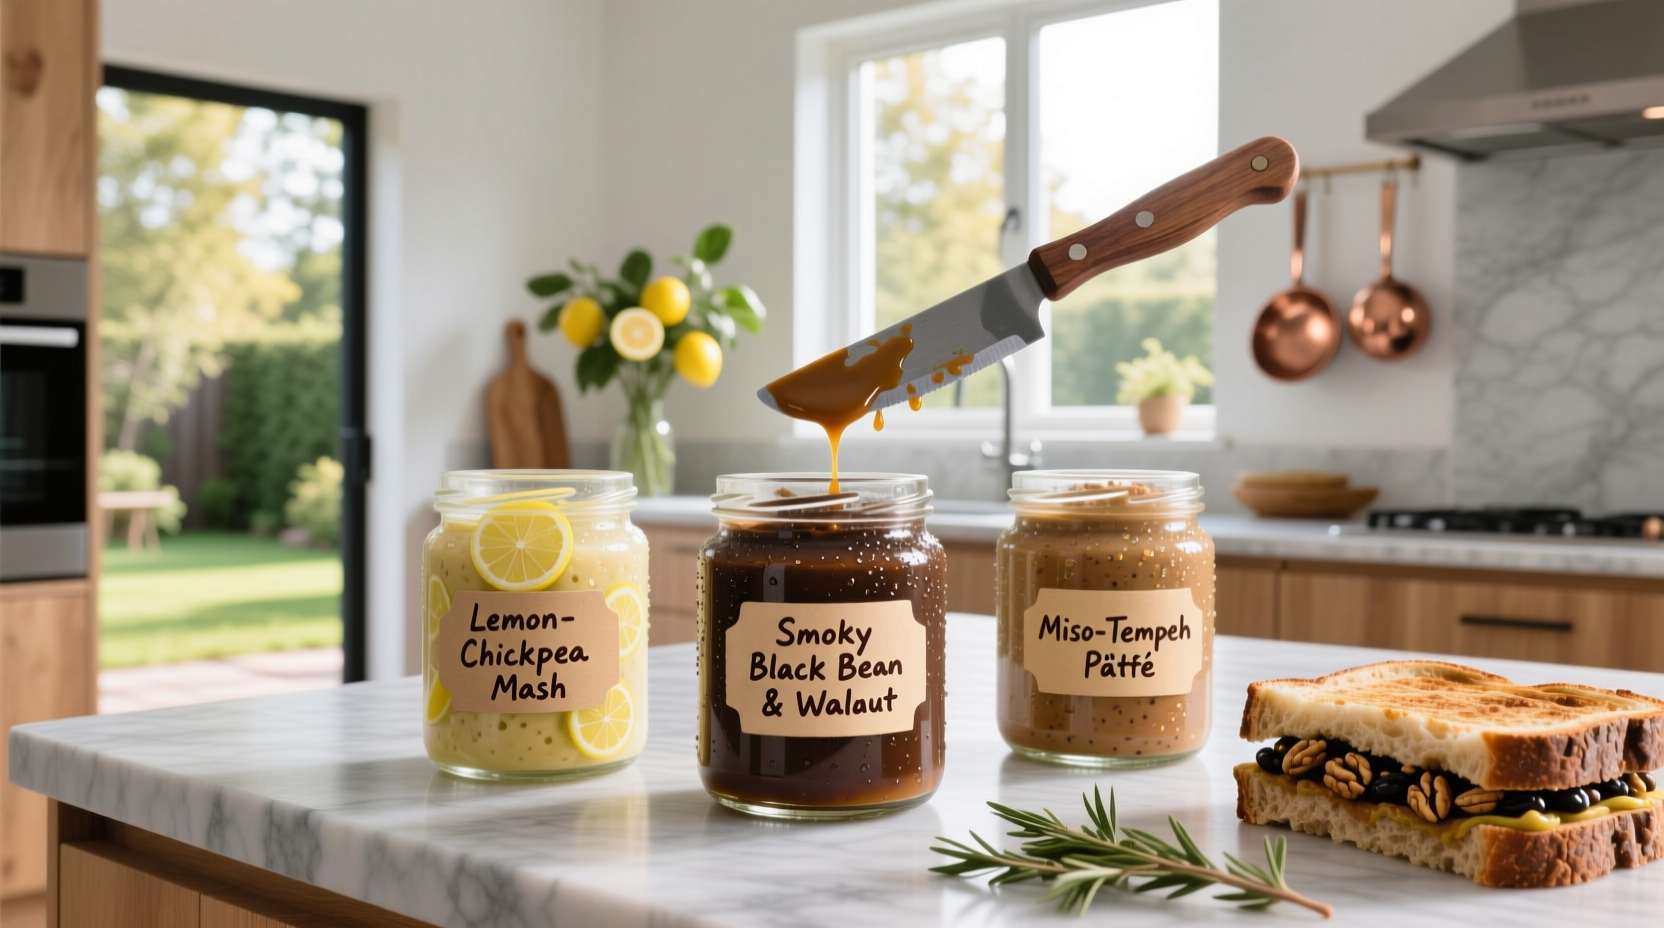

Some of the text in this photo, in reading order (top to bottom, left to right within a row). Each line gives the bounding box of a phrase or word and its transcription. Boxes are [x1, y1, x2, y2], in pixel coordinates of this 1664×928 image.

[470, 603, 575, 632] Lemon-
[1038, 614, 1191, 652] Miso-Tempeh
[776, 616, 872, 656] Smoky
[460, 638, 589, 676] Chickpea
[750, 651, 903, 682] Black Bean
[490, 672, 566, 701] Mash
[762, 687, 898, 718] & Walaut
